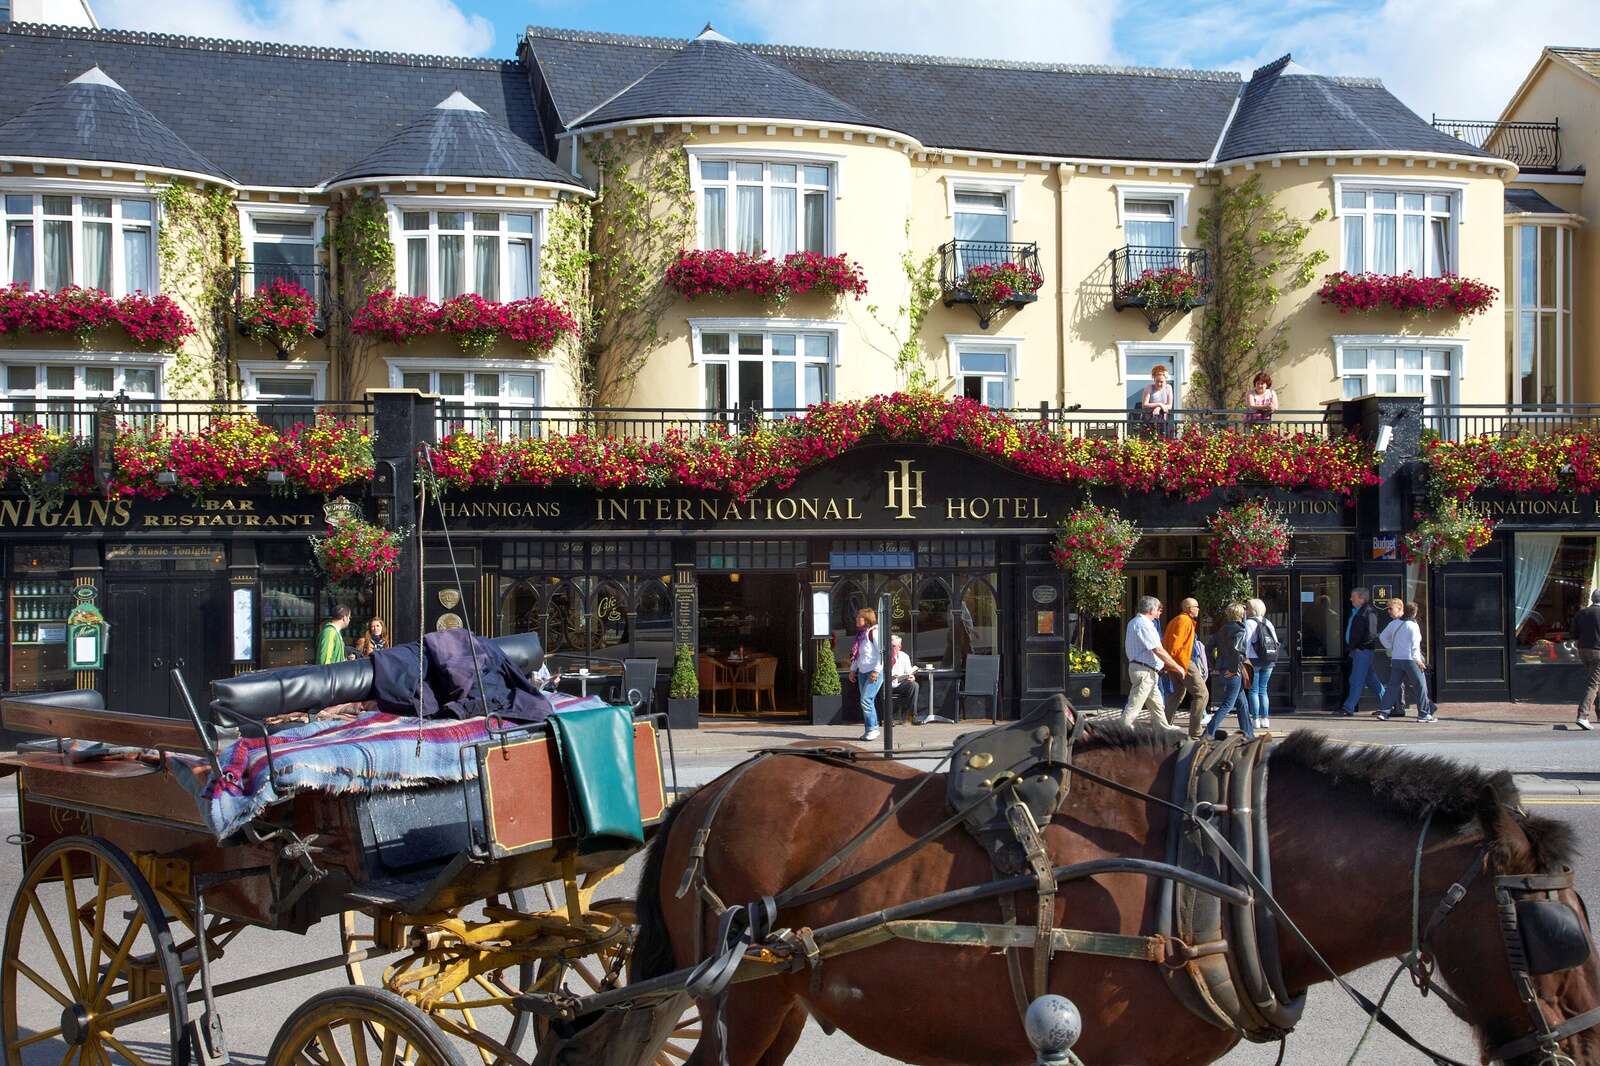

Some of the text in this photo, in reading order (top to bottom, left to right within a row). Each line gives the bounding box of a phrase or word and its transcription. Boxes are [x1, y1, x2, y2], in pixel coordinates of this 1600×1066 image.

[205, 499, 255, 511] BAR
[442, 502, 561, 517] HANNIGANS
[595, 497, 1048, 520] INTERNATIONAL HOTEL
[1266, 501, 1338, 513] CEPTION
[144, 514, 315, 526] RESTAURANT
[1372, 536, 1396, 552] Budget
[137, 546, 169, 556] Music
[173, 546, 211, 558] Tonight
